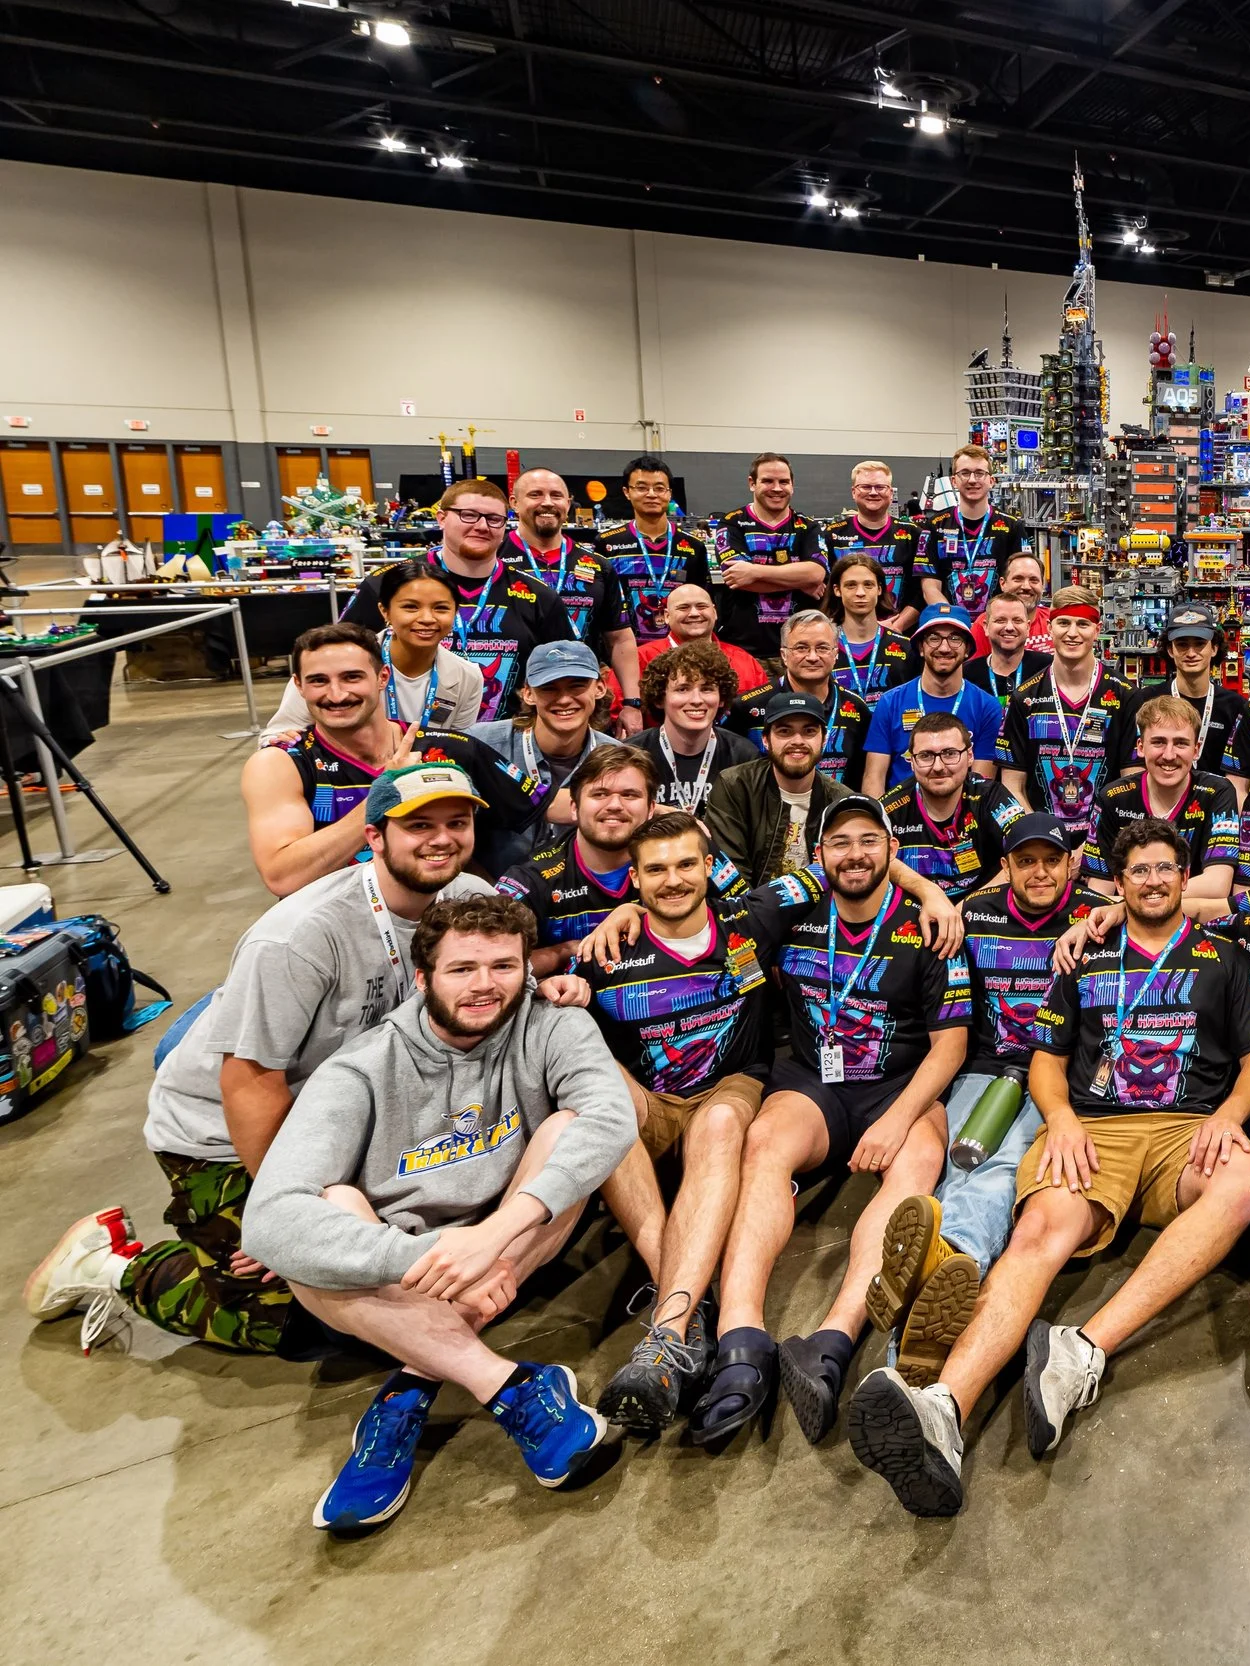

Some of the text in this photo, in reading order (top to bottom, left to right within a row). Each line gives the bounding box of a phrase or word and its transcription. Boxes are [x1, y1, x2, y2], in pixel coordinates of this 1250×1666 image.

[507, 588, 537, 603] brolug
[839, 709, 861, 722] brolug
[885, 795, 911, 814] EBELLUG
[965, 887, 1001, 902] REBELLUG
[973, 911, 1008, 925] Brickstuff
[891, 931, 923, 948] brolug
[366, 976, 384, 1000] THE
[984, 976, 1012, 990] NEW
[640, 997, 746, 1040] NEW HASHIMA
[1102, 1011, 1198, 1028] NEW HASHIMA
[825, 1053, 833, 1078] 1123
[403, 1142, 471, 1172] TRACK
